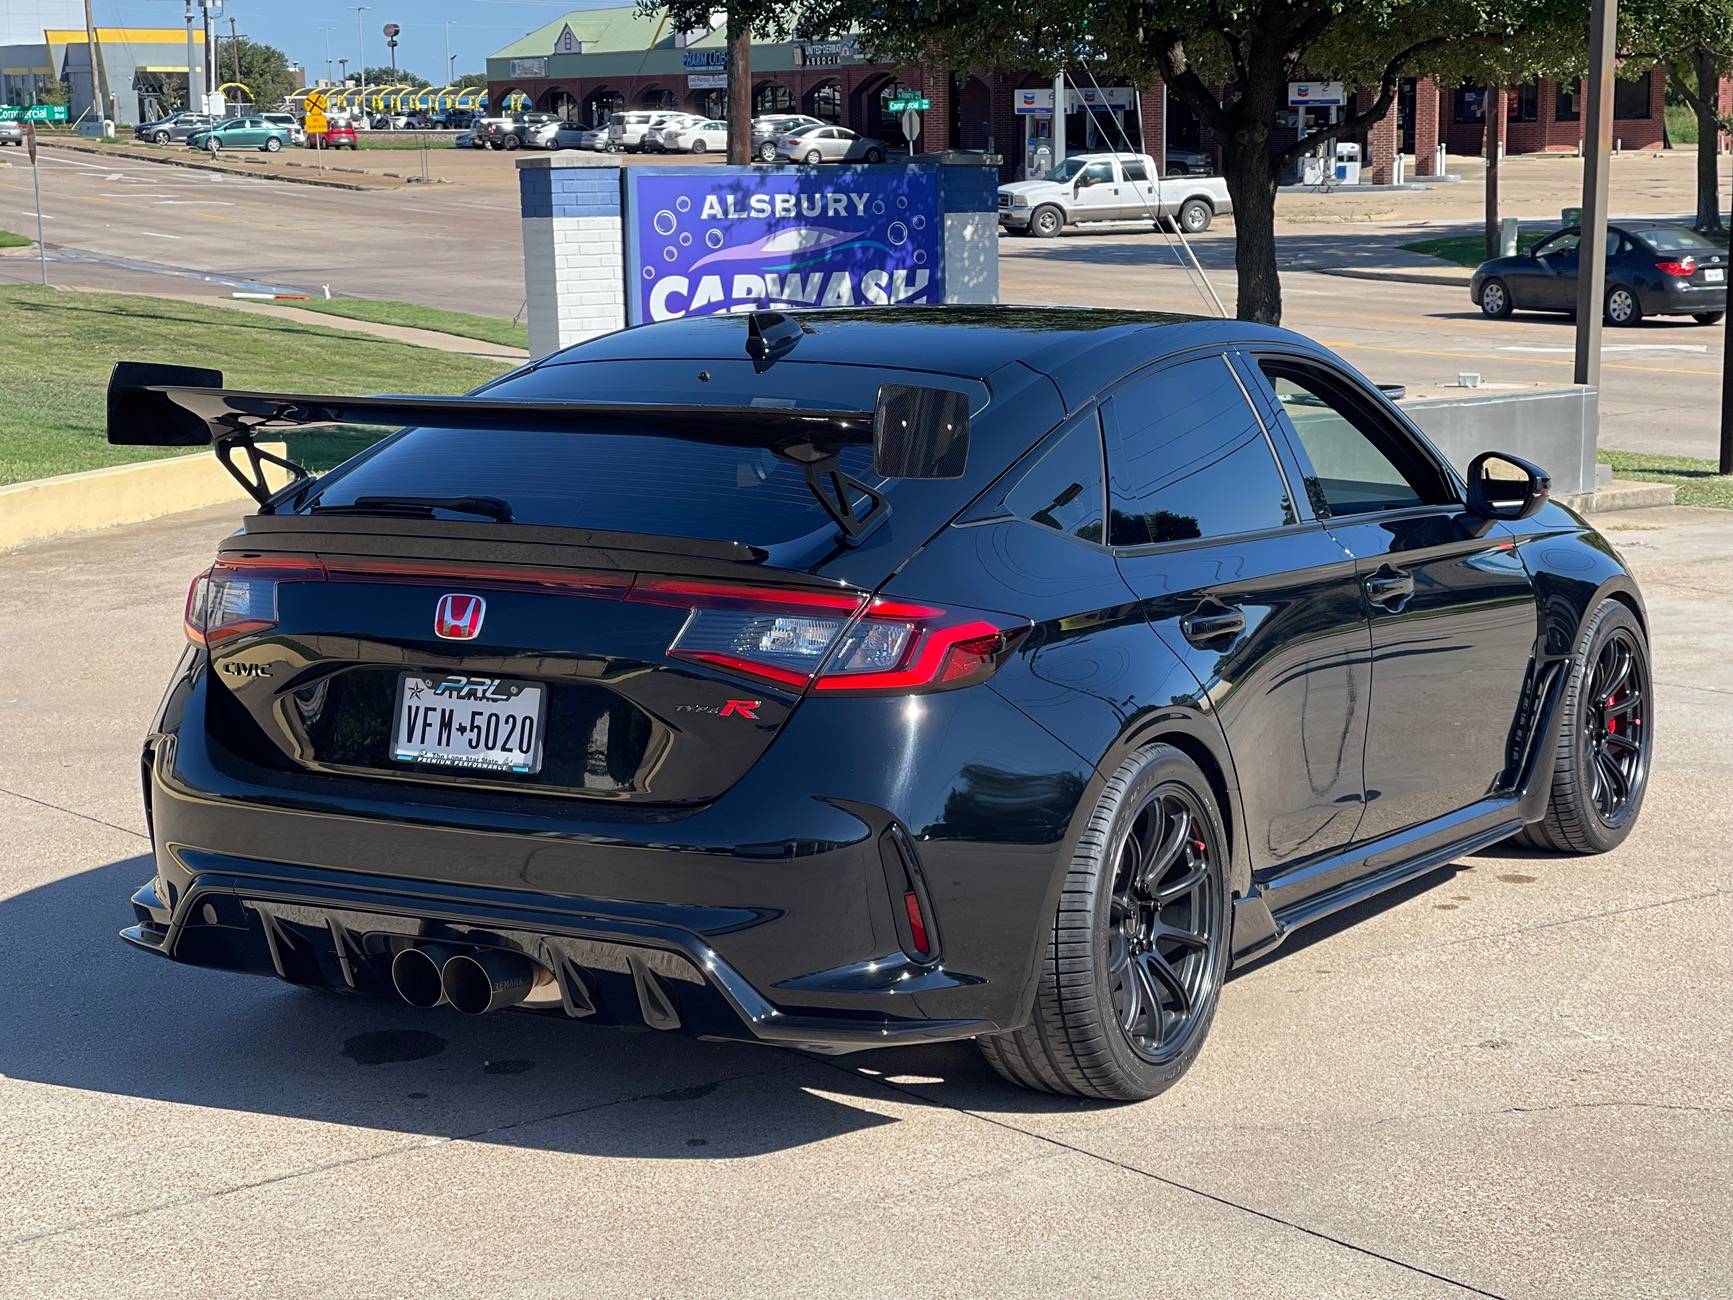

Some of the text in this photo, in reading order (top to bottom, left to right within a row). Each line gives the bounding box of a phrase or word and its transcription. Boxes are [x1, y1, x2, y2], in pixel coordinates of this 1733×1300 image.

[700, 193, 871, 220] ALSBURY
[649, 269, 931, 322] CARWASH
[223, 662, 274, 677] CIVIC
[434, 675, 509, 700] PRL
[720, 699, 762, 720] R
[406, 704, 534, 755] VFM 5020
[417, 757, 508, 771] PREMIUM PERFORMANCE
[431, 752, 445, 760] The
